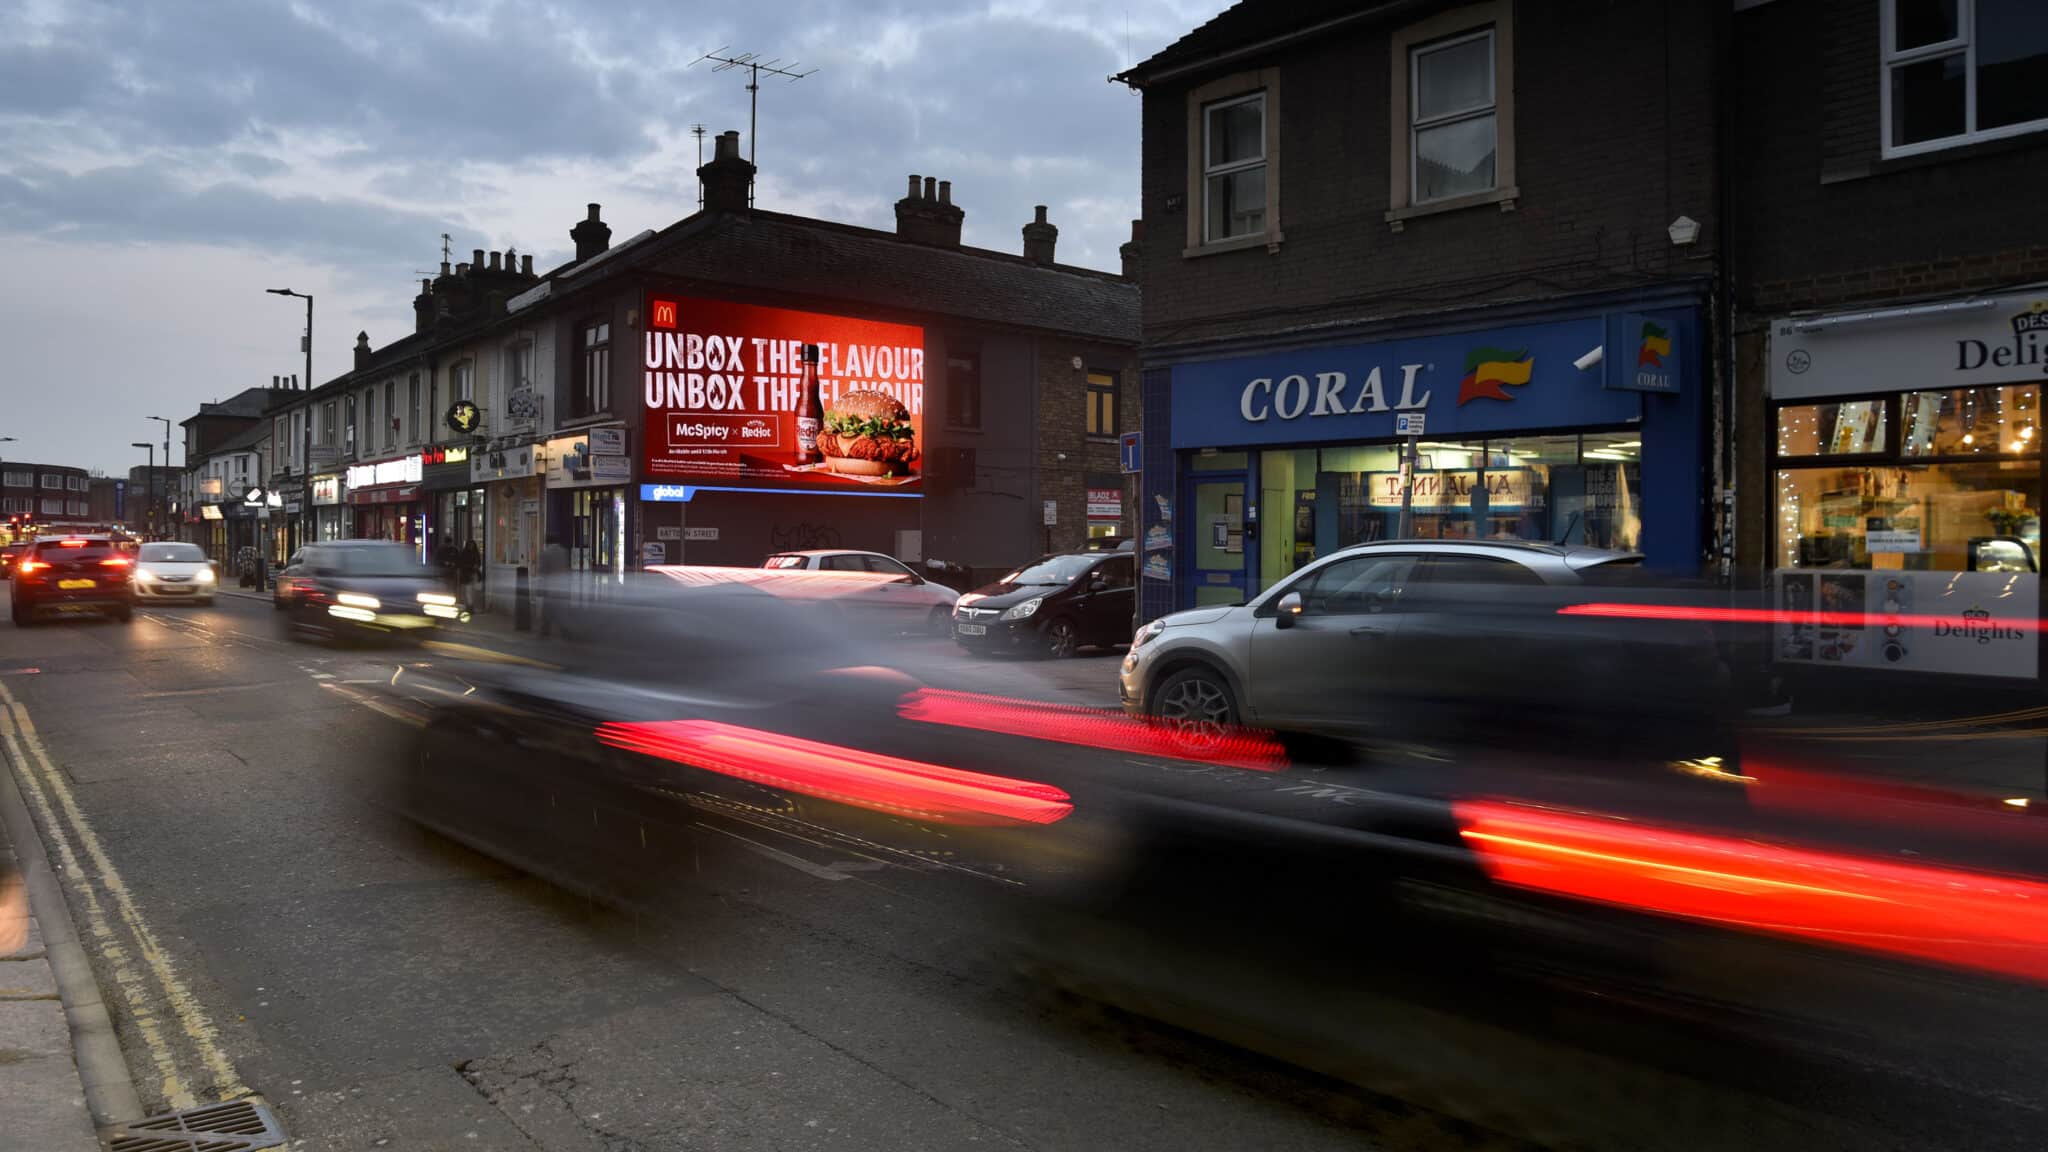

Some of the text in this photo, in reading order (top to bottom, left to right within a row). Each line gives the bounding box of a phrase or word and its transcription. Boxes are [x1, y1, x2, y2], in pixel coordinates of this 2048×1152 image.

[645, 331, 924, 381] UNBOX THE FLAVOUR
[644, 372, 746, 412] UNBOX
[752, 376, 800, 412] THE
[1240, 364, 1431, 422] CORAL
[1637, 372, 1671, 388] CORAL
[676, 422, 729, 440] McSpicy
[741, 426, 771, 438] RedHot
[652, 485, 684, 501] global
[1934, 619, 2025, 645] Delights
